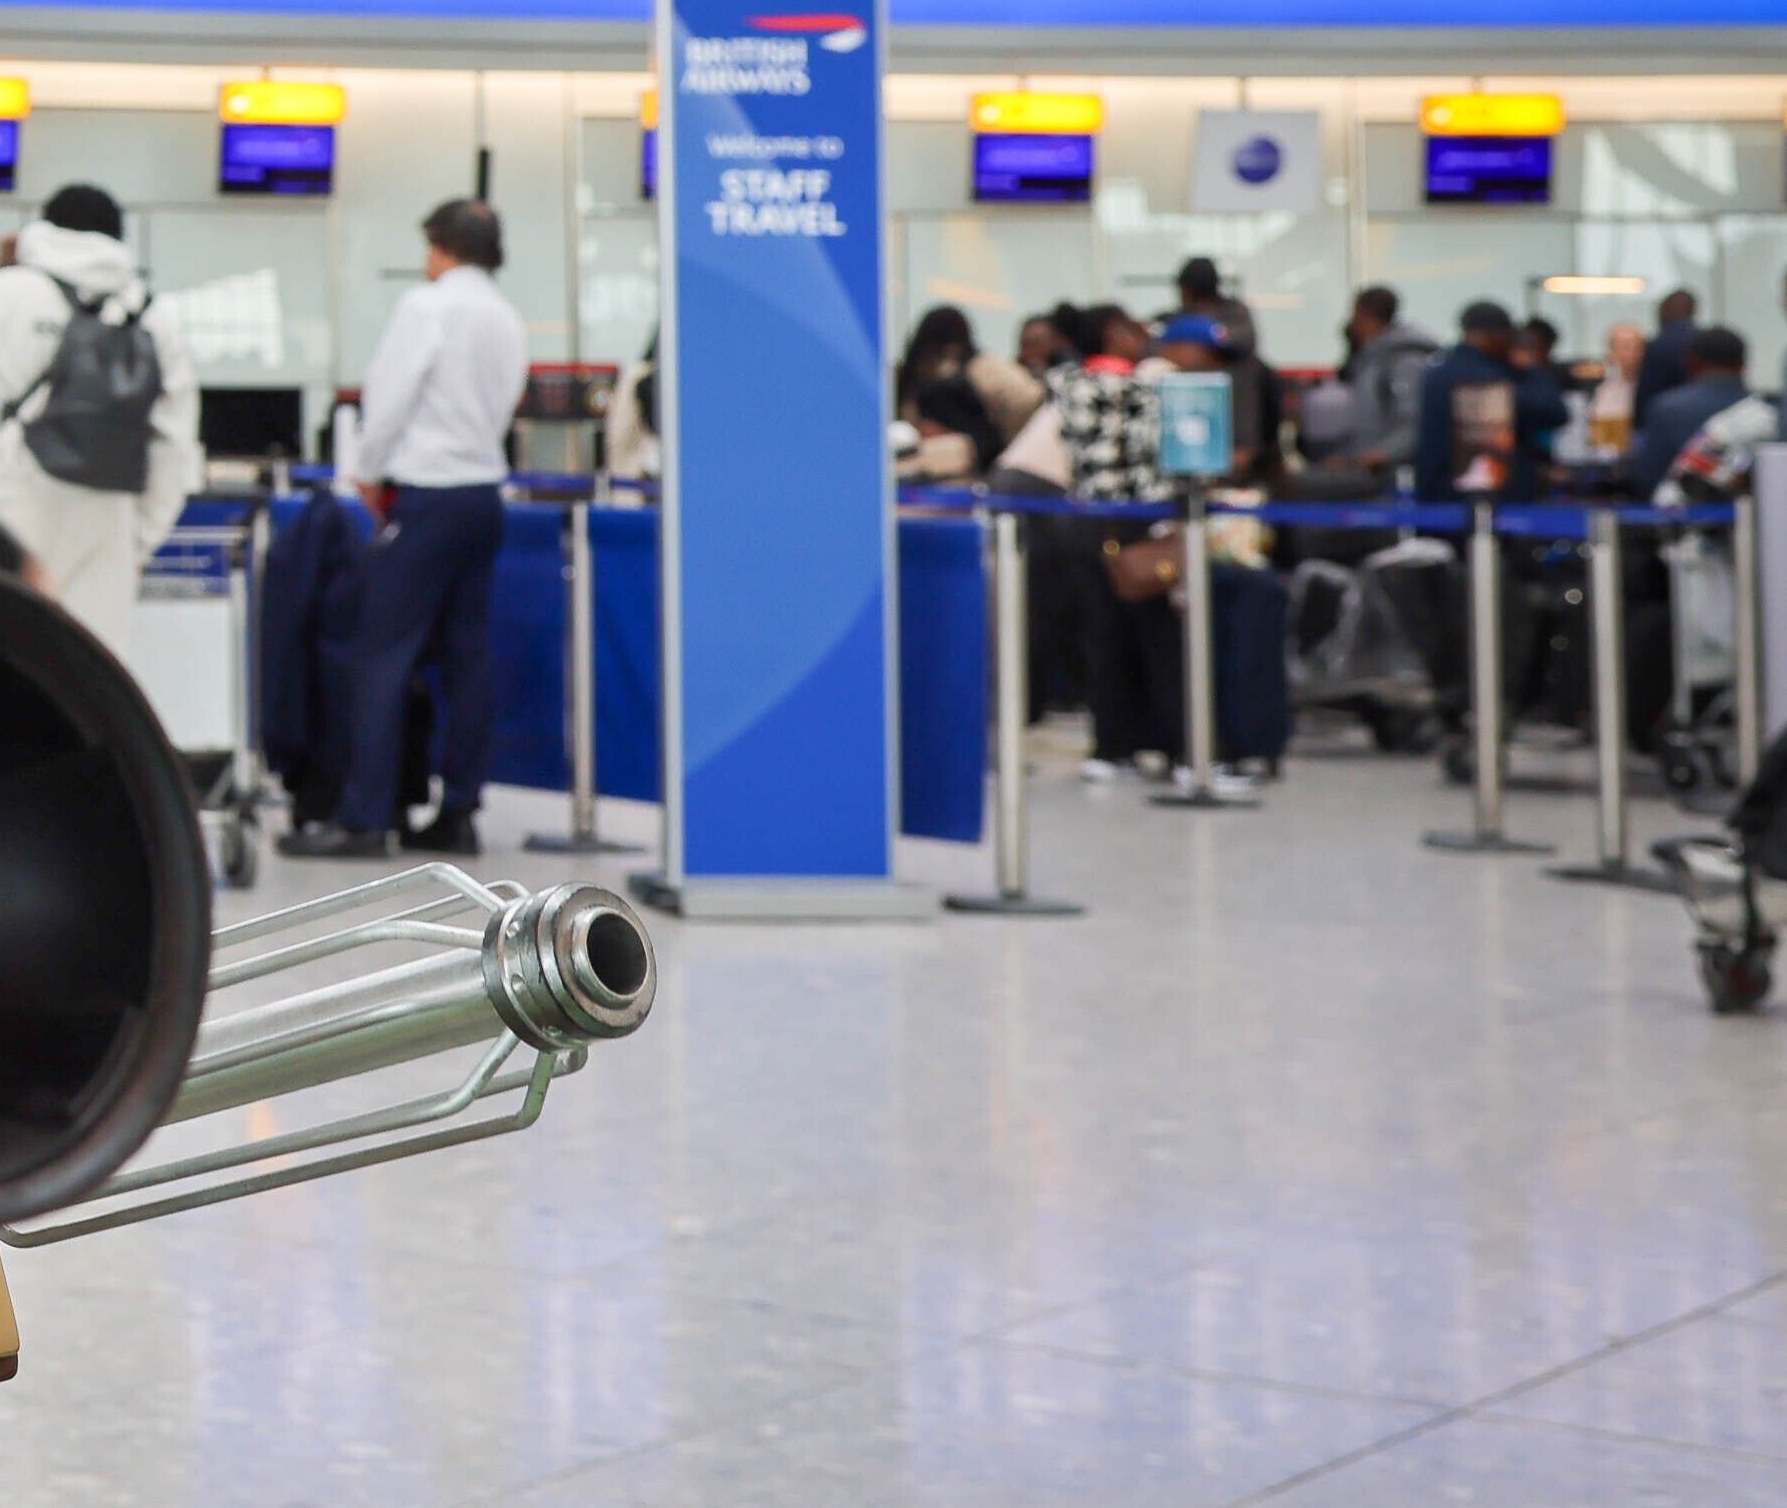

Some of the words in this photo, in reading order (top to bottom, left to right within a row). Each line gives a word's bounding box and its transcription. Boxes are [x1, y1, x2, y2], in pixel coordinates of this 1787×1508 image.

[684, 37, 809, 65] BRITISH
[680, 66, 812, 95] AIRWAYS
[720, 169, 831, 201] STAFF
[704, 201, 847, 236] TRAVEL
